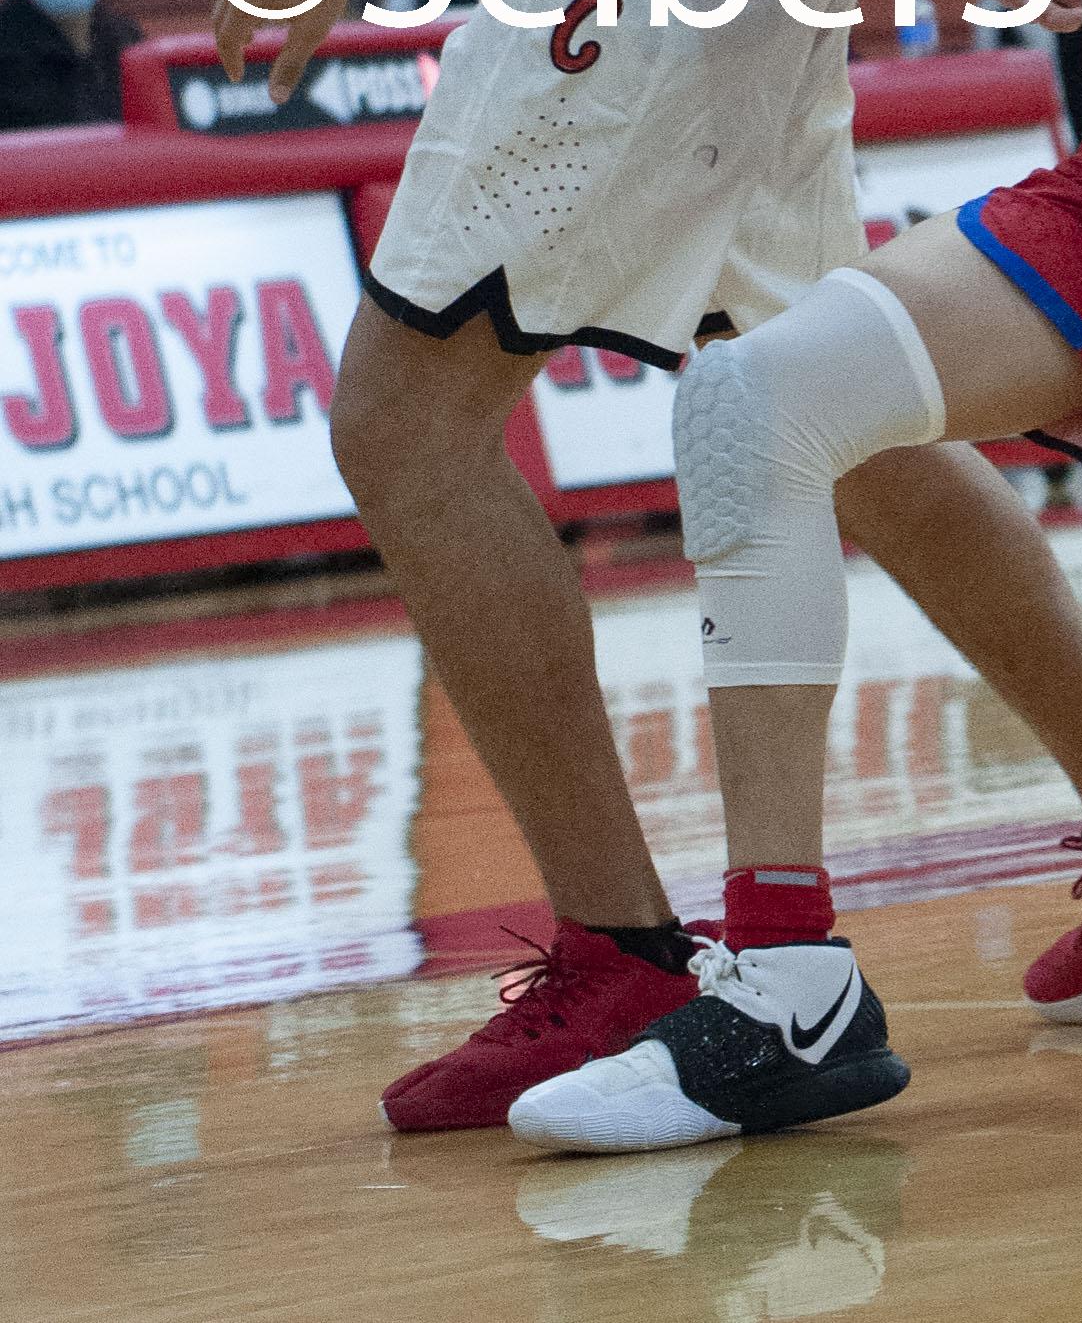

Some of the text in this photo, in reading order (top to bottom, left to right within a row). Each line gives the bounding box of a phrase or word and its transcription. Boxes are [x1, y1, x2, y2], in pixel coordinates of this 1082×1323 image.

[94, 231, 138, 267] TO
[2, 279, 335, 452] JOYA
[51, 461, 248, 525] SCHOOL
